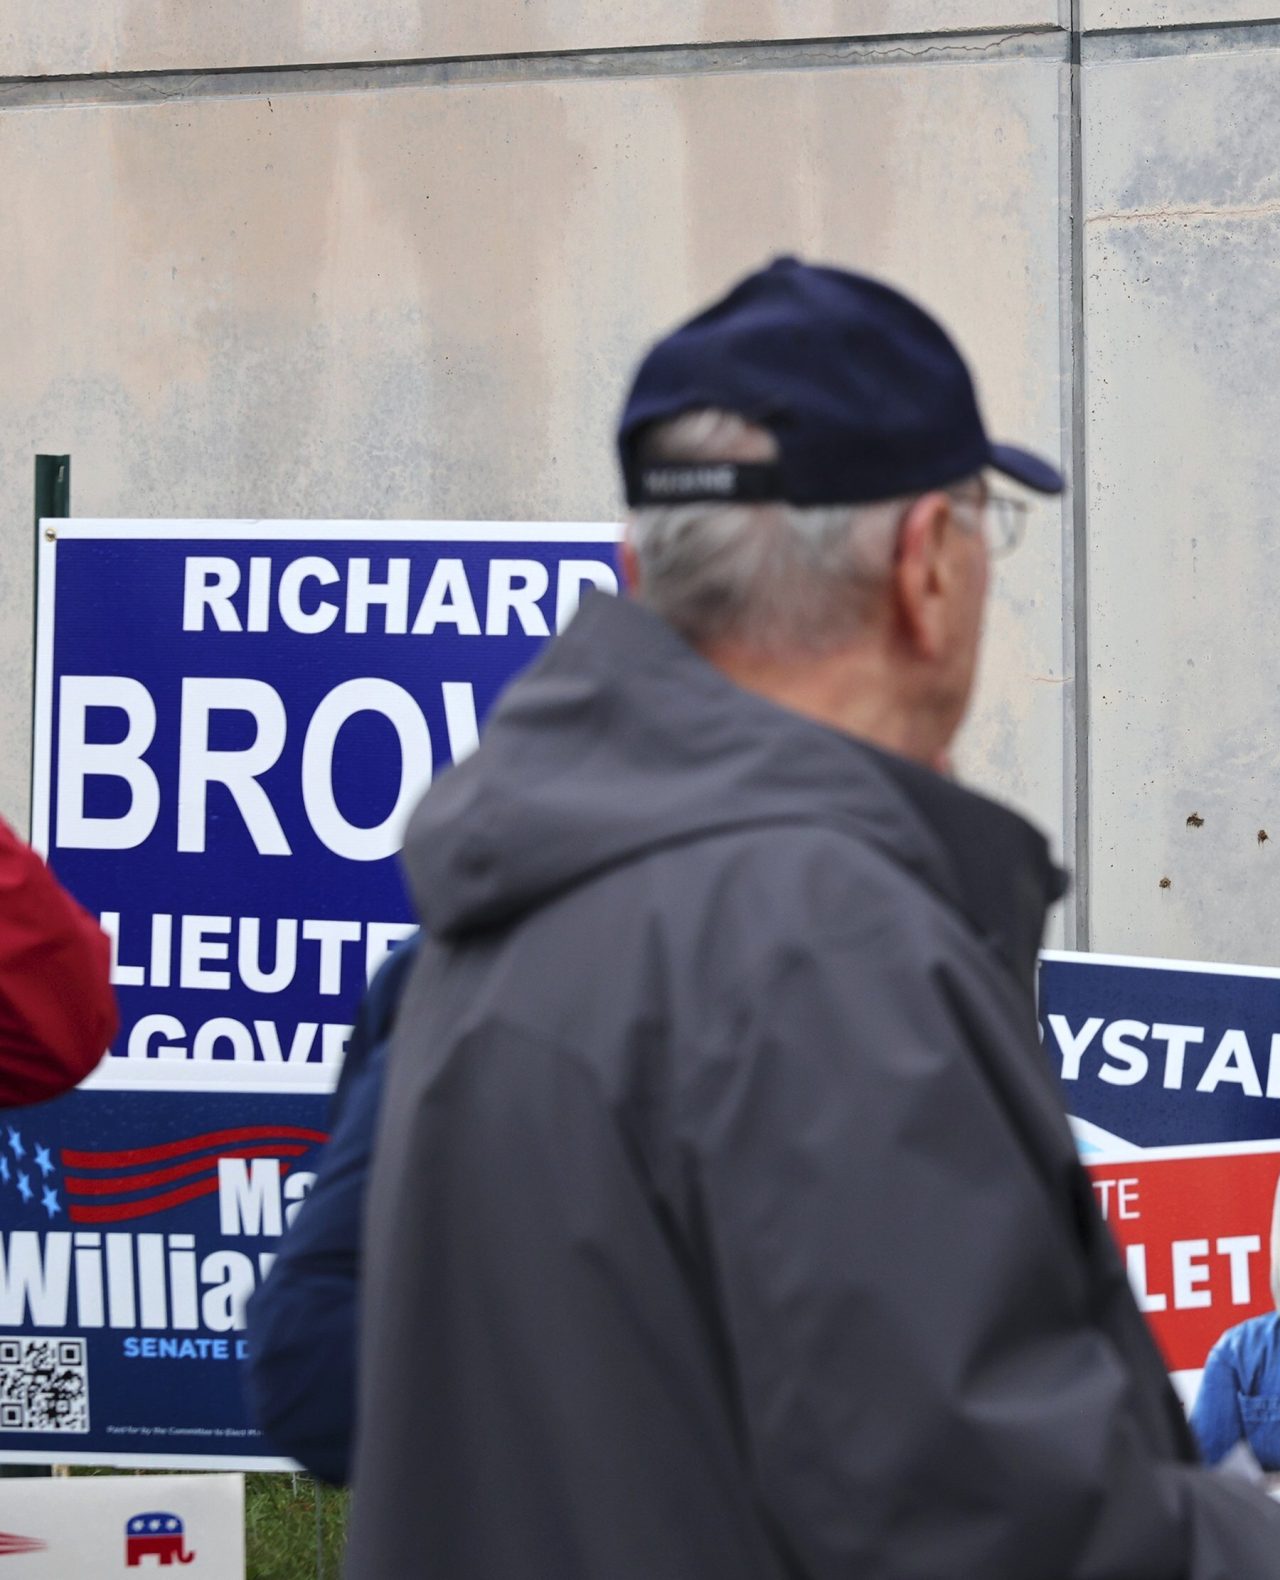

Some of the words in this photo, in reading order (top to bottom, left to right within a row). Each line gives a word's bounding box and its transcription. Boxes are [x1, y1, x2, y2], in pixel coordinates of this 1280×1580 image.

[181, 555, 619, 637] RICHARD
[55, 674, 482, 862] BRO
[1091, 1177, 1141, 1221] TE
[0, 1230, 279, 1333] Willia
[1125, 1234, 1261, 1313] LET
[123, 1336, 230, 1361] SENATE
